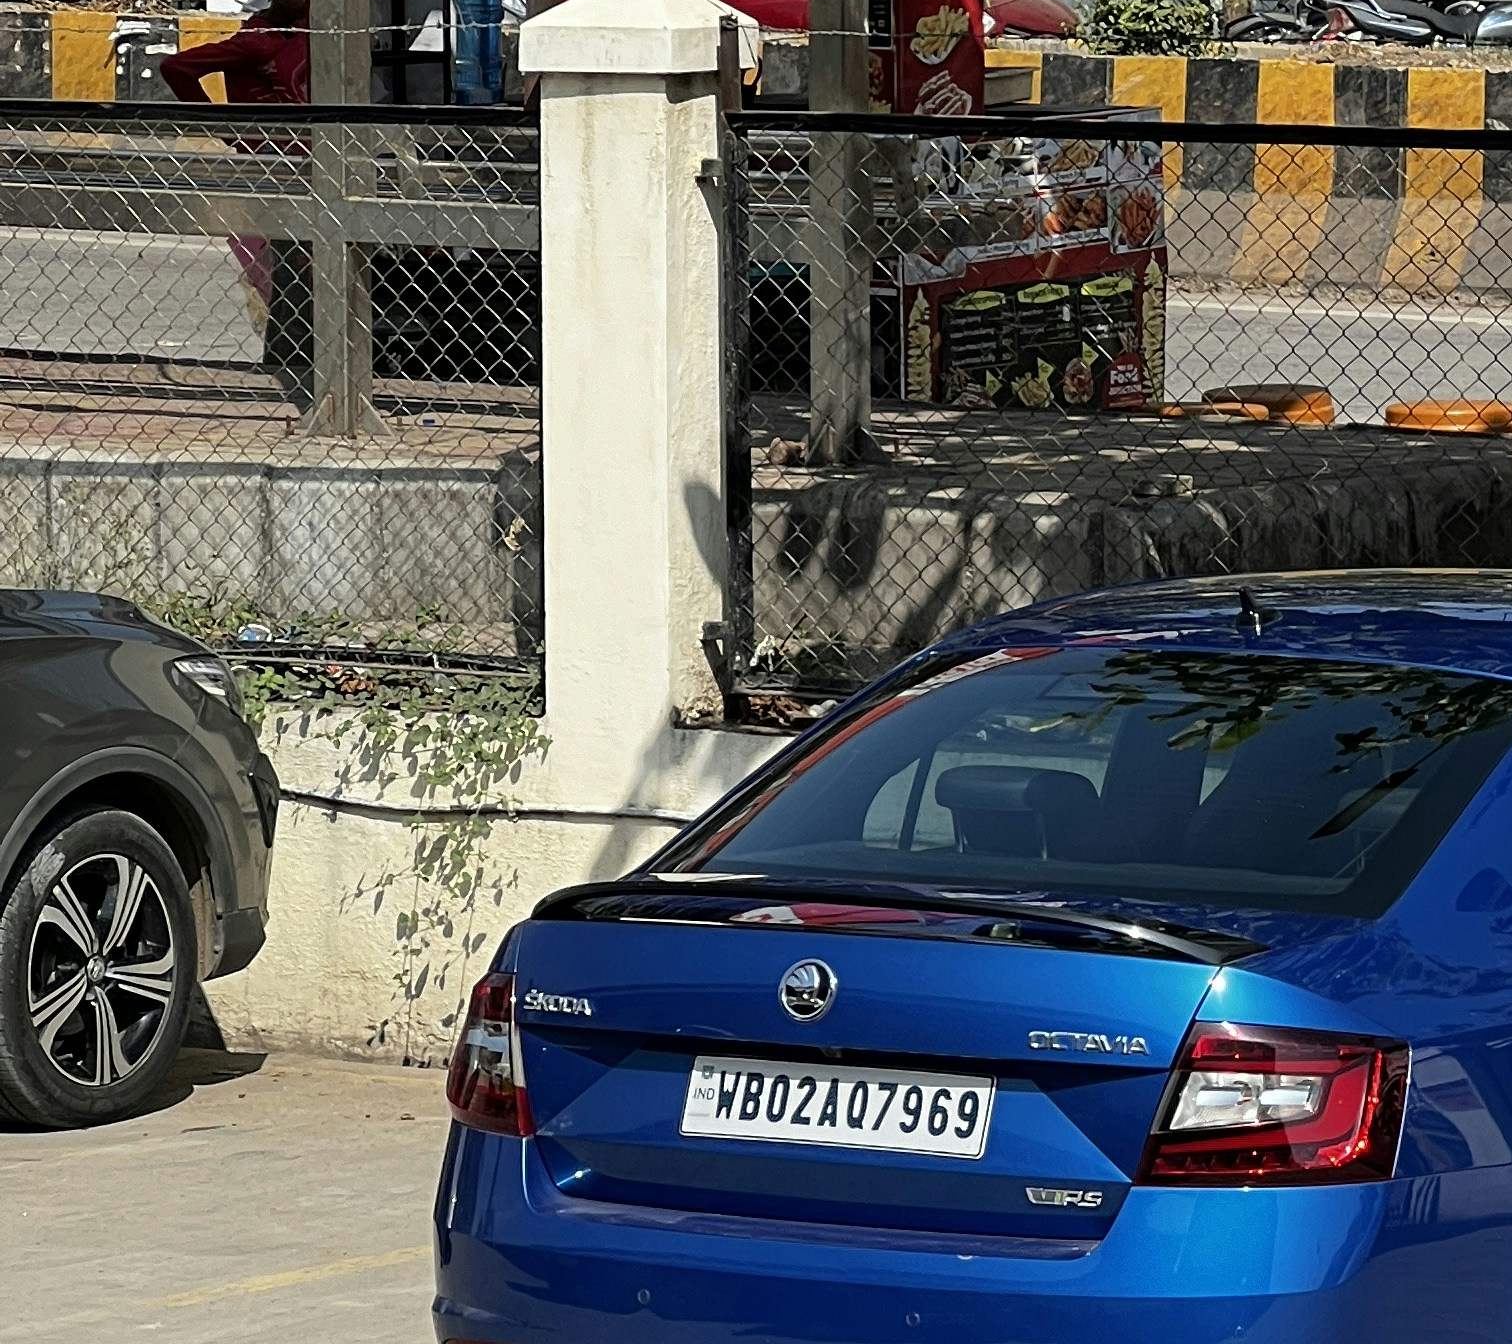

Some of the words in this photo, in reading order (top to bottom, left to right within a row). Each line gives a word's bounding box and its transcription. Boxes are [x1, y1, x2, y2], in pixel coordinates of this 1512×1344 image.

[1028, 1031, 1150, 1056] OCTAVIA
[692, 1087, 715, 1102] IND
[715, 1070, 979, 1140] WB02AQ7969
